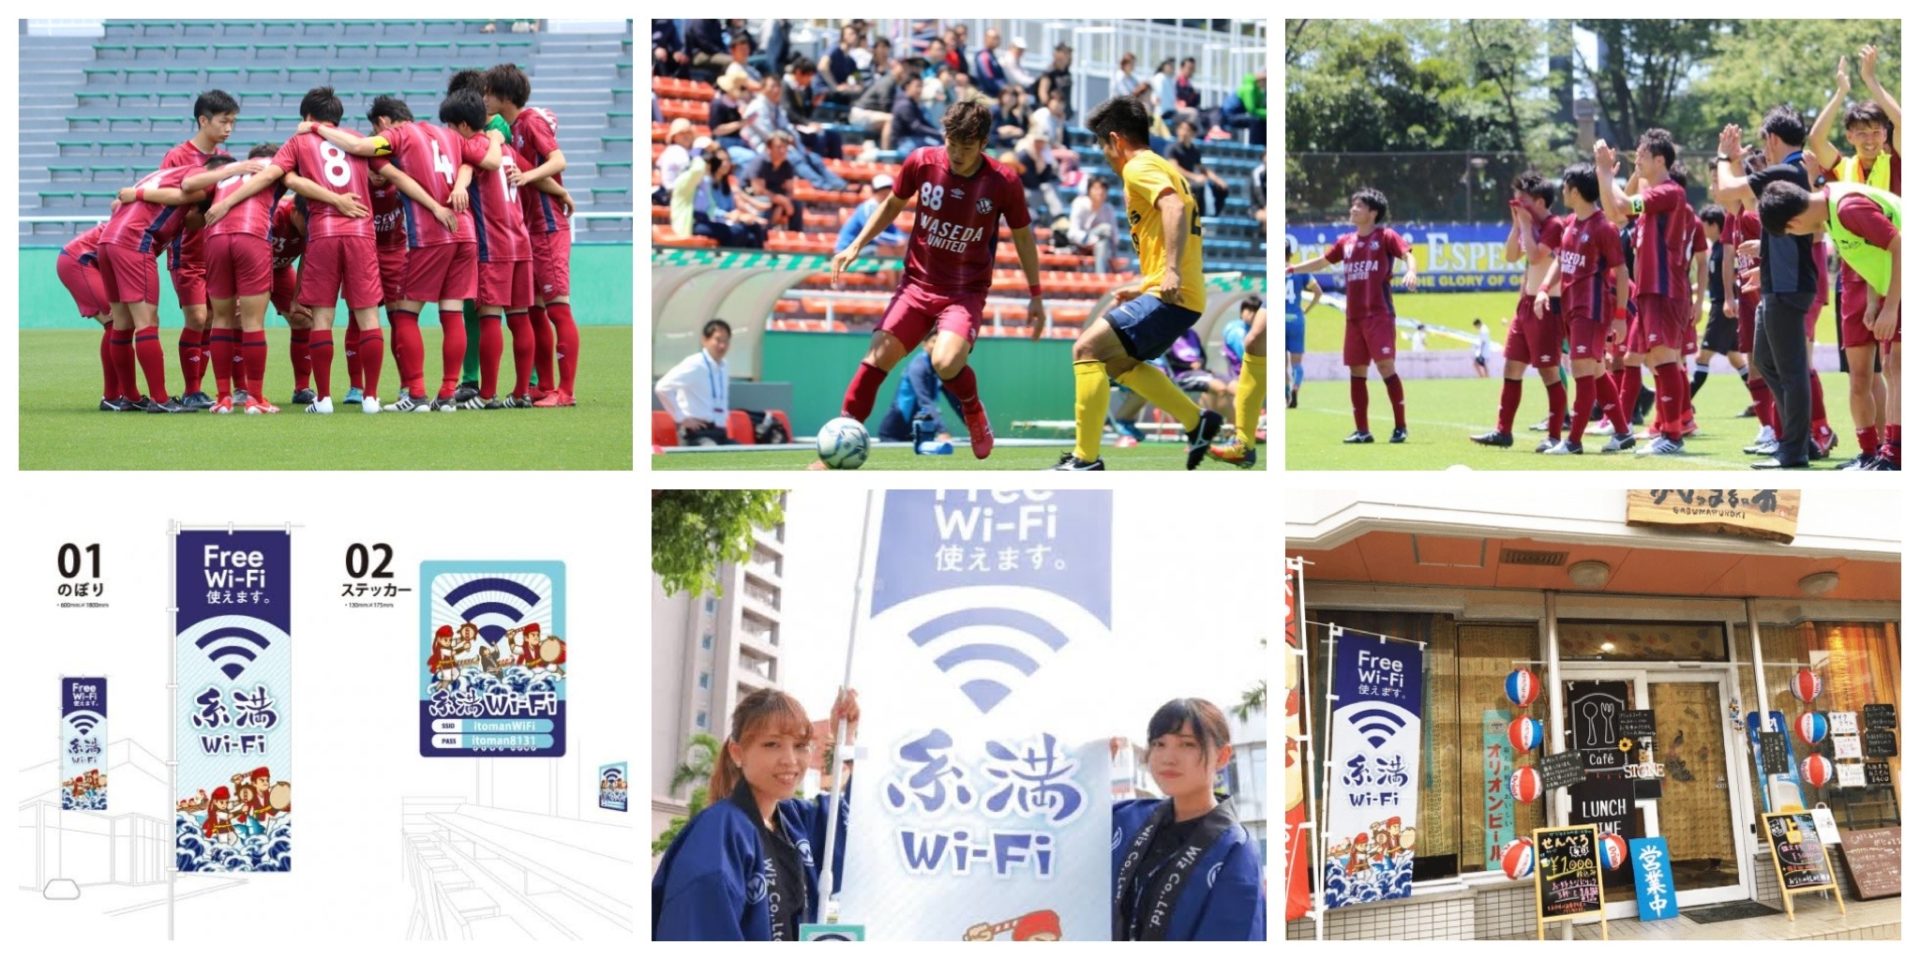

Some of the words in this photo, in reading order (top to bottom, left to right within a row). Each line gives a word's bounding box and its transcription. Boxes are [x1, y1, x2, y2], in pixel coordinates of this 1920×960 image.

[319, 140, 350, 187] 8
[431, 139, 454, 184] 4
[921, 182, 944, 211] 88
[920, 213, 984, 242] WASEDA
[927, 235, 967, 254] UNITED
[1438, 275, 1484, 287] GLORY
[1487, 275, 1505, 287] OF
[933, 504, 1057, 542] Wi-Fi
[57, 543, 101, 579] 01
[204, 545, 264, 567] Free
[345, 542, 394, 579] 02
[935, 544, 1065, 571] 使えます。
[204, 569, 266, 588] Wi-Fi
[57, 582, 104, 598] のぼり
[206, 590, 270, 604] 使えます。
[341, 583, 412, 598] ステッカー
[1358, 650, 1403, 672] Free
[72, 682, 97, 692] Free
[1358, 668, 1404, 688] Wi-Fi
[72, 693, 97, 701] Wi-Fi
[1358, 685, 1406, 699] 使えます。
[193, 686, 278, 729] 糸満
[473, 720, 536, 731] itomanWiFi
[201, 735, 265, 754] Wi-Fi
[441, 738, 457, 746] PASS
[471, 735, 536, 746] itoman8131
[71, 756, 97, 764] Wi-Fi
[1589, 753, 1615, 766] Café
[887, 728, 1082, 821] 糸満
[1343, 754, 1408, 787] 糸満
[1623, 763, 1665, 779] STONE
[1349, 792, 1399, 807] Wi-Fi
[1487, 743, 1504, 861] オリオンビール
[1582, 799, 1627, 818] LUNCH
[1599, 821, 1622, 836] IME
[1541, 834, 1589, 850] せんべろ
[901, 830, 1051, 874] Wi-Fi
[1176, 845, 1202, 870] Wiz
[763, 858, 777, 887] Wiz
[1639, 845, 1668, 918] 営業中
